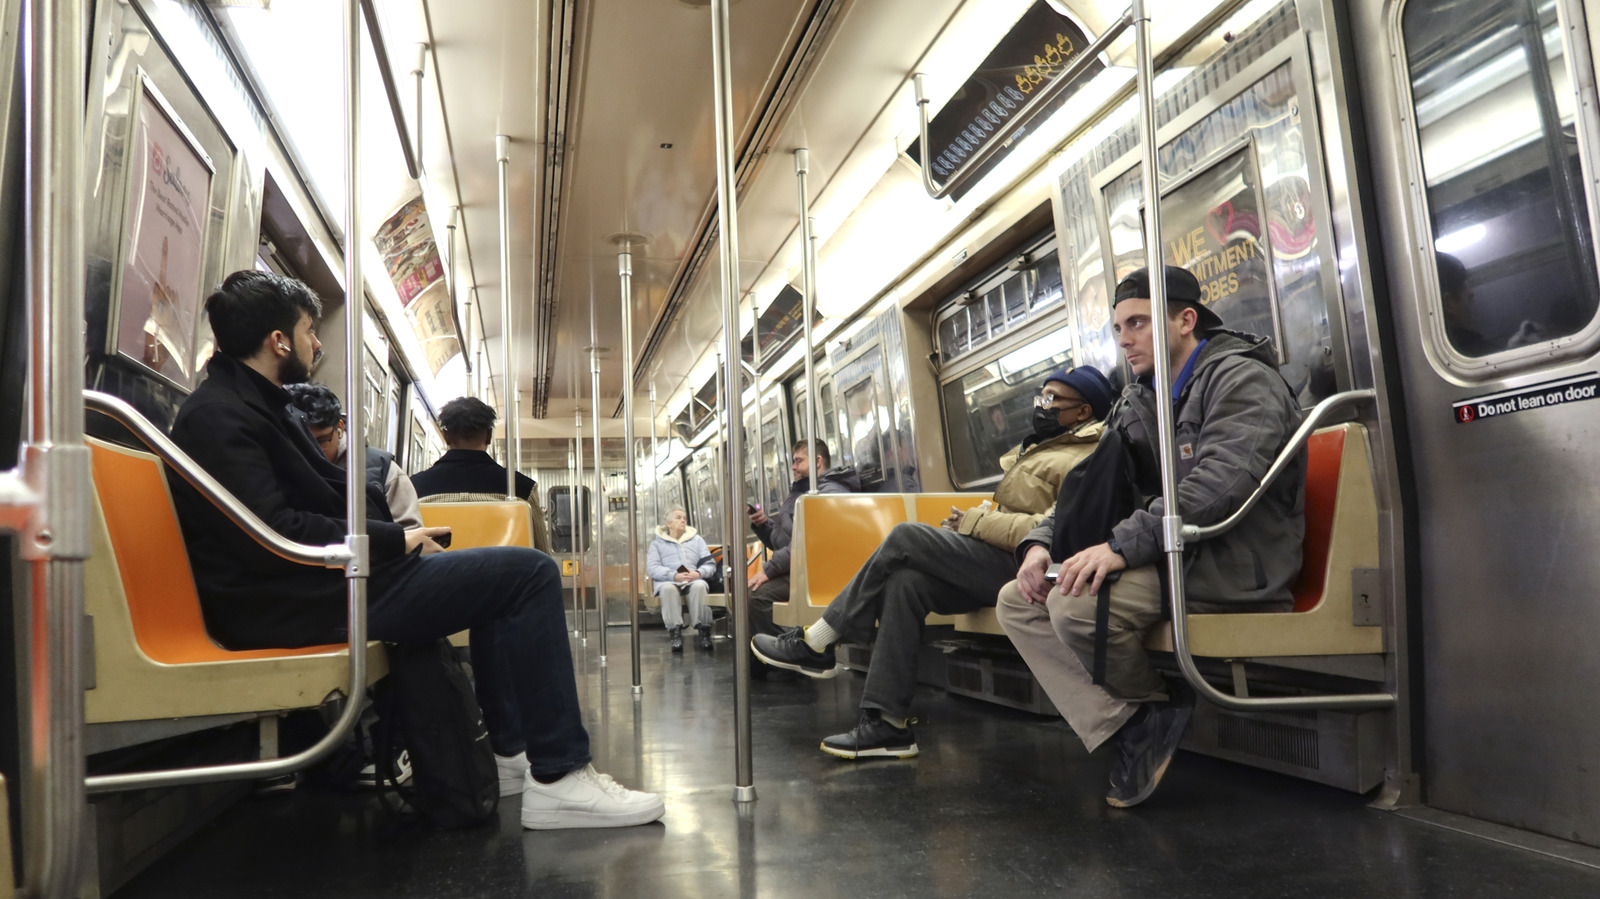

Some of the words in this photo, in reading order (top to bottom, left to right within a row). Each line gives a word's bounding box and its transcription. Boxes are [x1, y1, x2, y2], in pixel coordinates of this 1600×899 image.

[1170, 226, 1207, 268] WE
[1190, 237, 1255, 282] MITMENT
[1200, 272, 1239, 305] OBES
[1478, 404, 1496, 417] Do
[1496, 399, 1517, 414] not
[1518, 394, 1545, 409] lean
[1546, 391, 1563, 403] on
[1565, 385, 1597, 401] door
